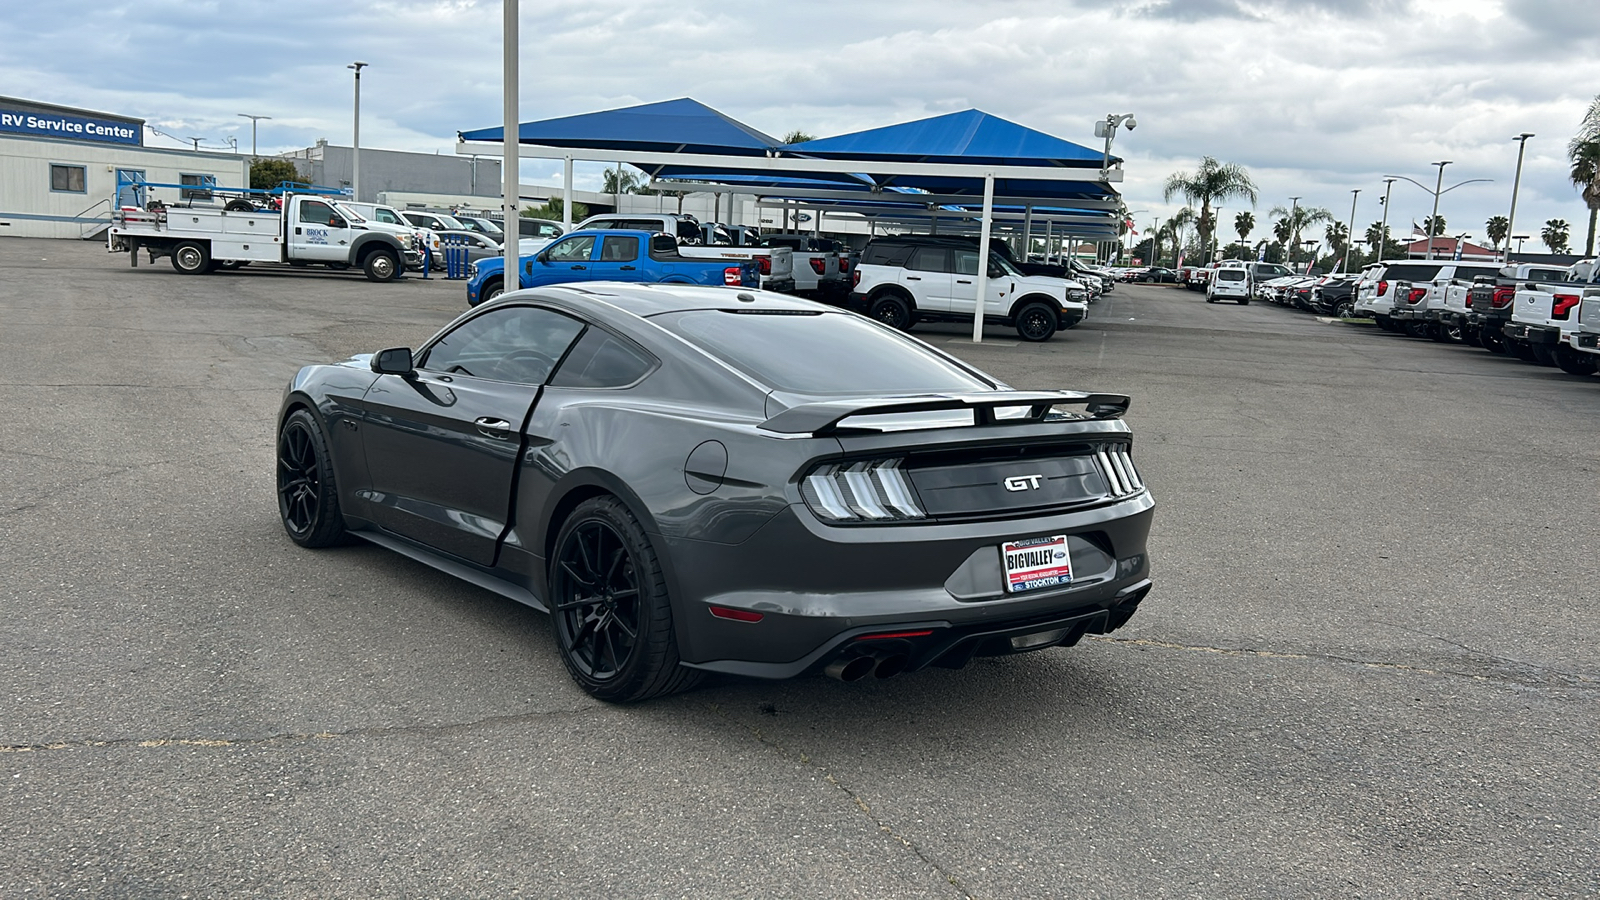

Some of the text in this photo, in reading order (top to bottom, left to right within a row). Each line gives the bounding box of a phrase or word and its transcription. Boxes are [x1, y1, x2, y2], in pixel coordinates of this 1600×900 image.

[1, 114, 134, 138] RV Service Center
[306, 228, 329, 237] BROCK
[1004, 474, 1043, 491] GT
[1007, 549, 1053, 570] BIGVALLEY
[1025, 576, 1059, 588] STOCKTON
